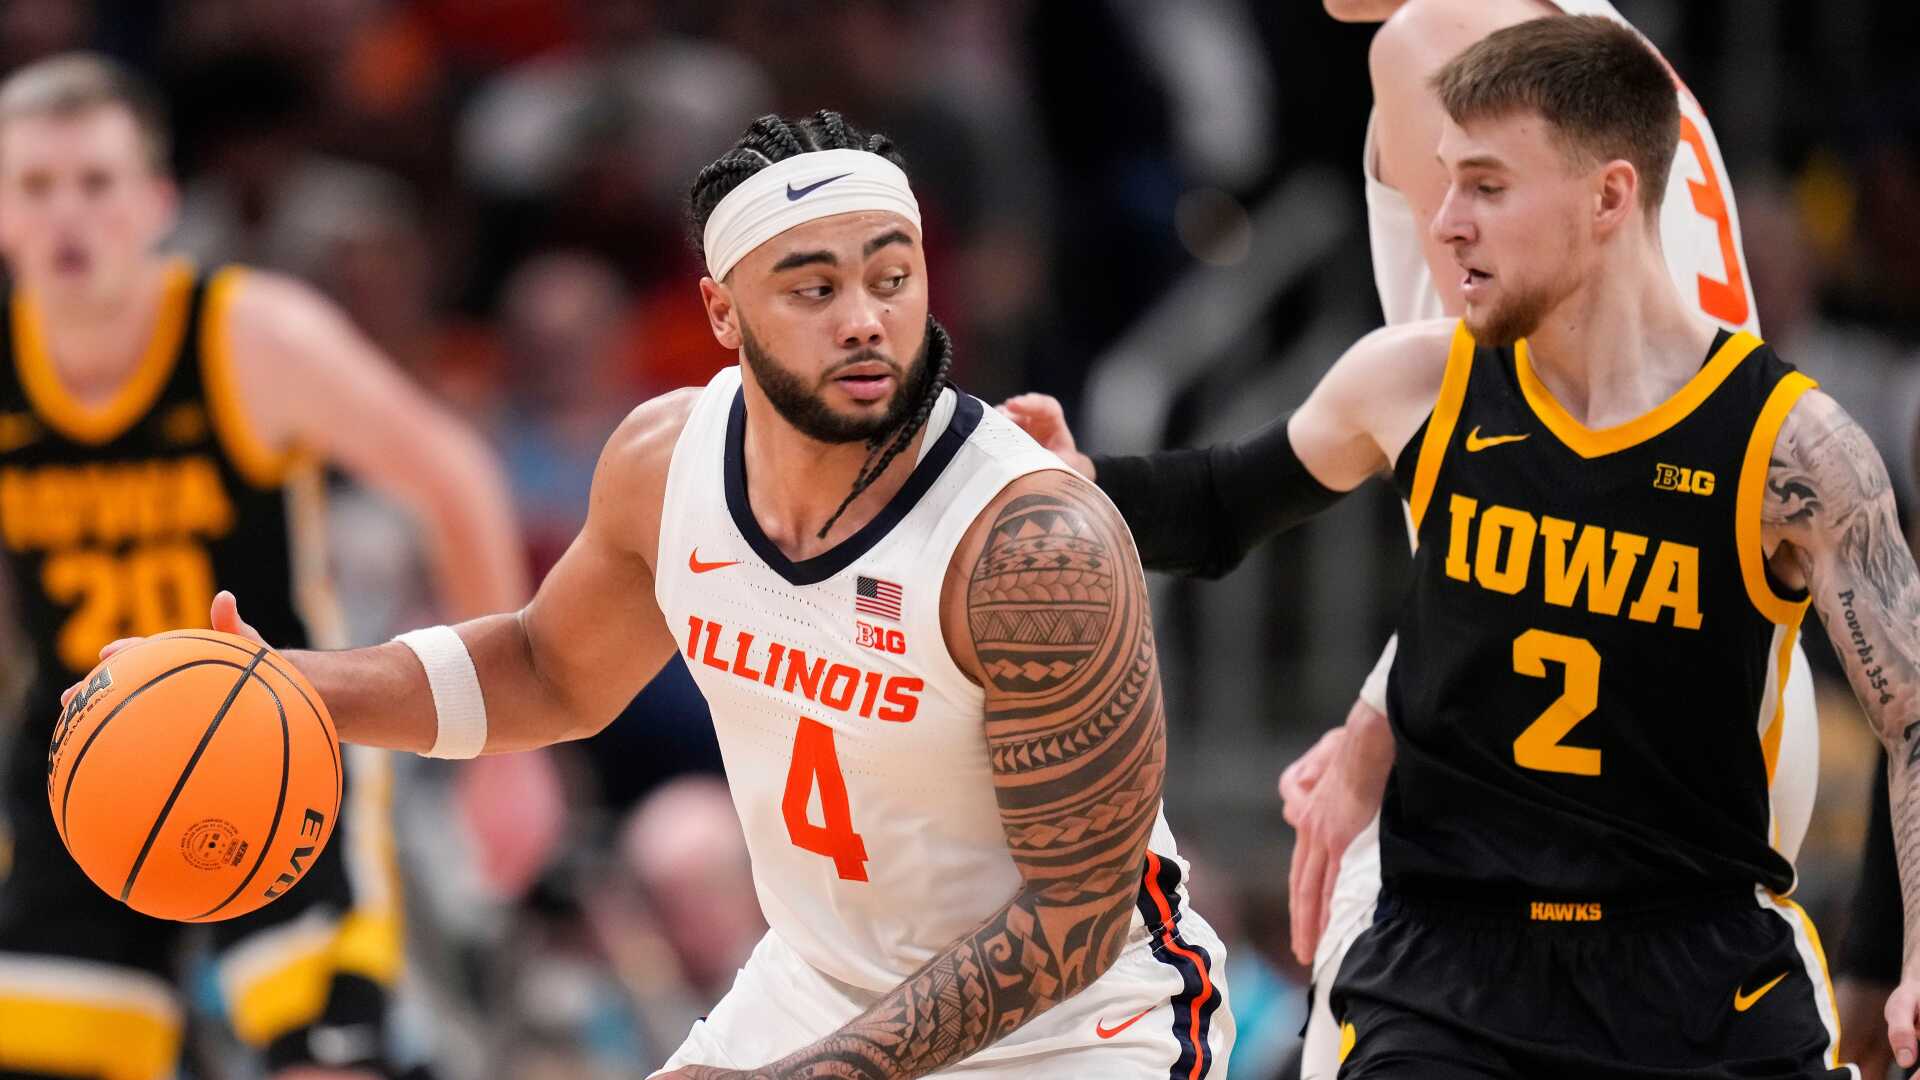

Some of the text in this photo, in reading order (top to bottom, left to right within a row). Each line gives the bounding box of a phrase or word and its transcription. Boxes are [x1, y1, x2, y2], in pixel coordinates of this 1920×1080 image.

[1680, 113, 1748, 326] 3
[43, 545, 216, 671] 20
[1445, 493, 1703, 630] IOWA
[1838, 590, 1873, 665] Proverbs
[1513, 628, 1601, 776] 2
[264, 808, 324, 898] EVO
[782, 716, 869, 882] 4
[1530, 902, 1602, 921] HAWKS
